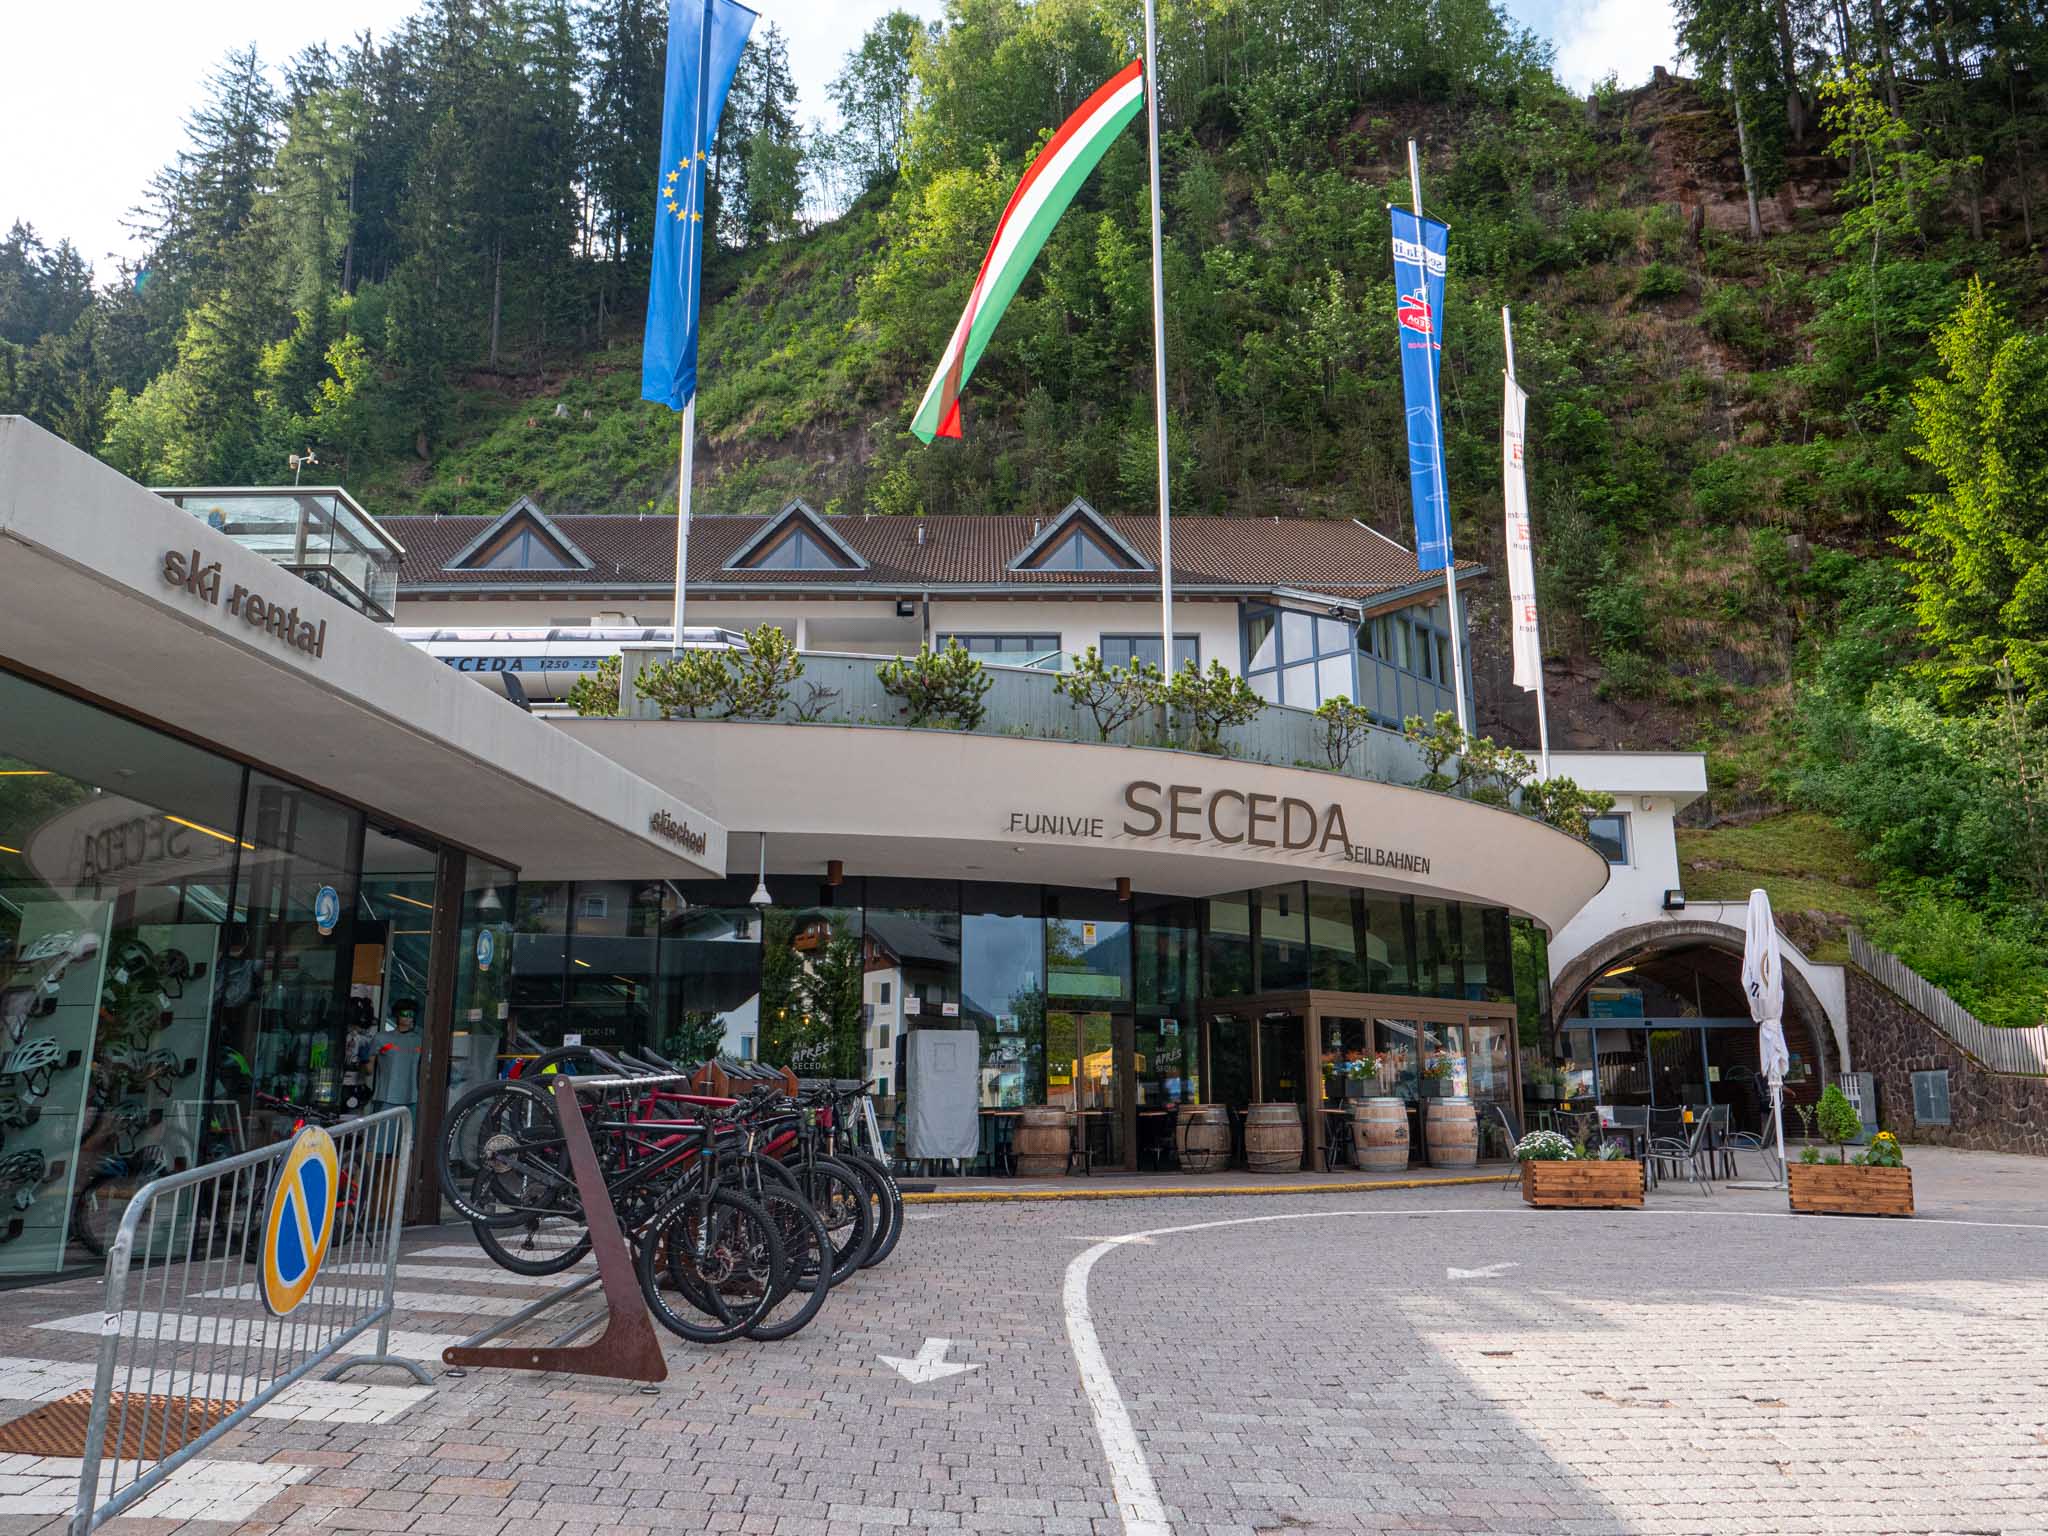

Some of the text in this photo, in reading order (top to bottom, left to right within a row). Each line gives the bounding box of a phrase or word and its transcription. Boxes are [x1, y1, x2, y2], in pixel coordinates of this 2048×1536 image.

[163, 549, 327, 658] ski rental
[540, 659, 569, 669] 1250
[1010, 813, 1104, 838] FUNIVIE
[1123, 780, 1351, 855] SECEDA
[1344, 844, 1430, 874] SEILBAHNEN
[792, 1062, 828, 1070] SECEDA
